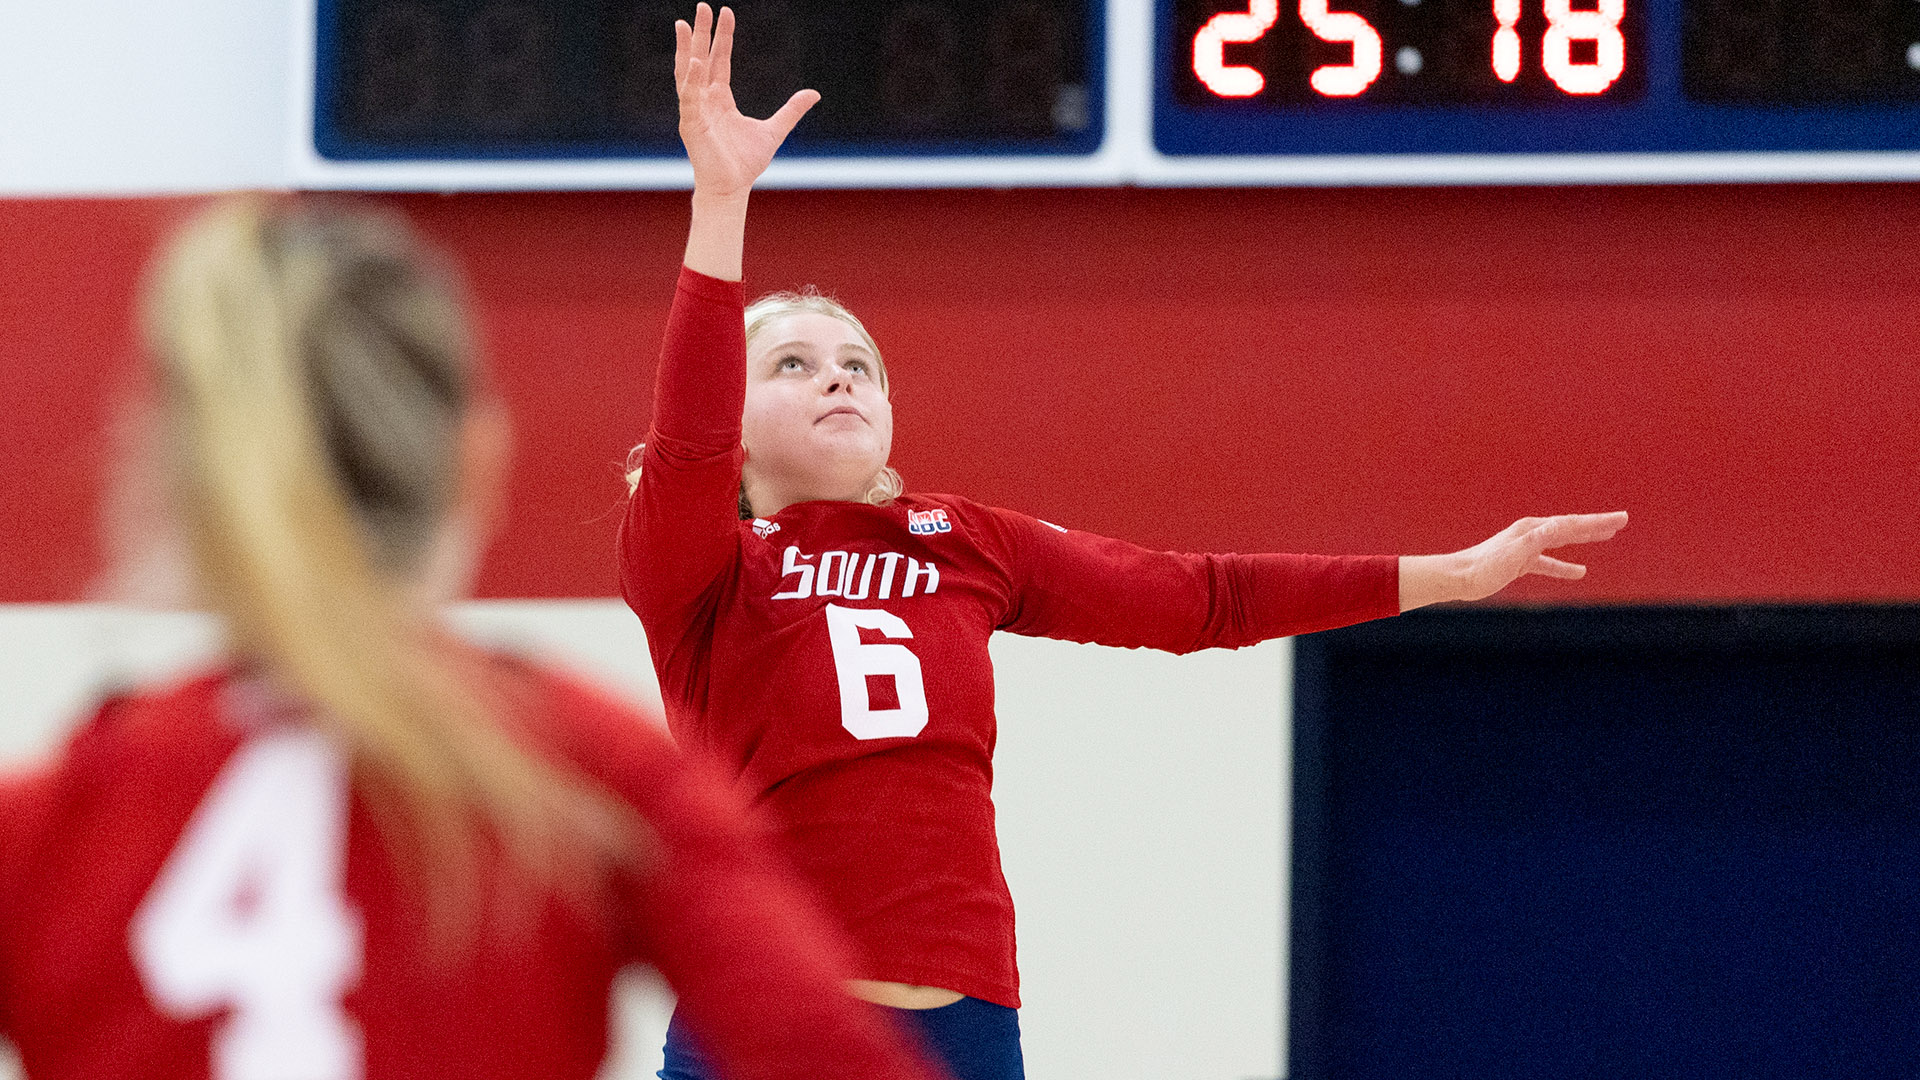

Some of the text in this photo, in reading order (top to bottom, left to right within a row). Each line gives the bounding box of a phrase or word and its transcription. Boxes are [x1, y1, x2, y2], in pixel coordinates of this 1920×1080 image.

[1191, 0, 1627, 98] 25 18
[771, 545, 940, 600] SOUTH
[826, 603, 929, 740] 6
[130, 728, 363, 1080] 4
